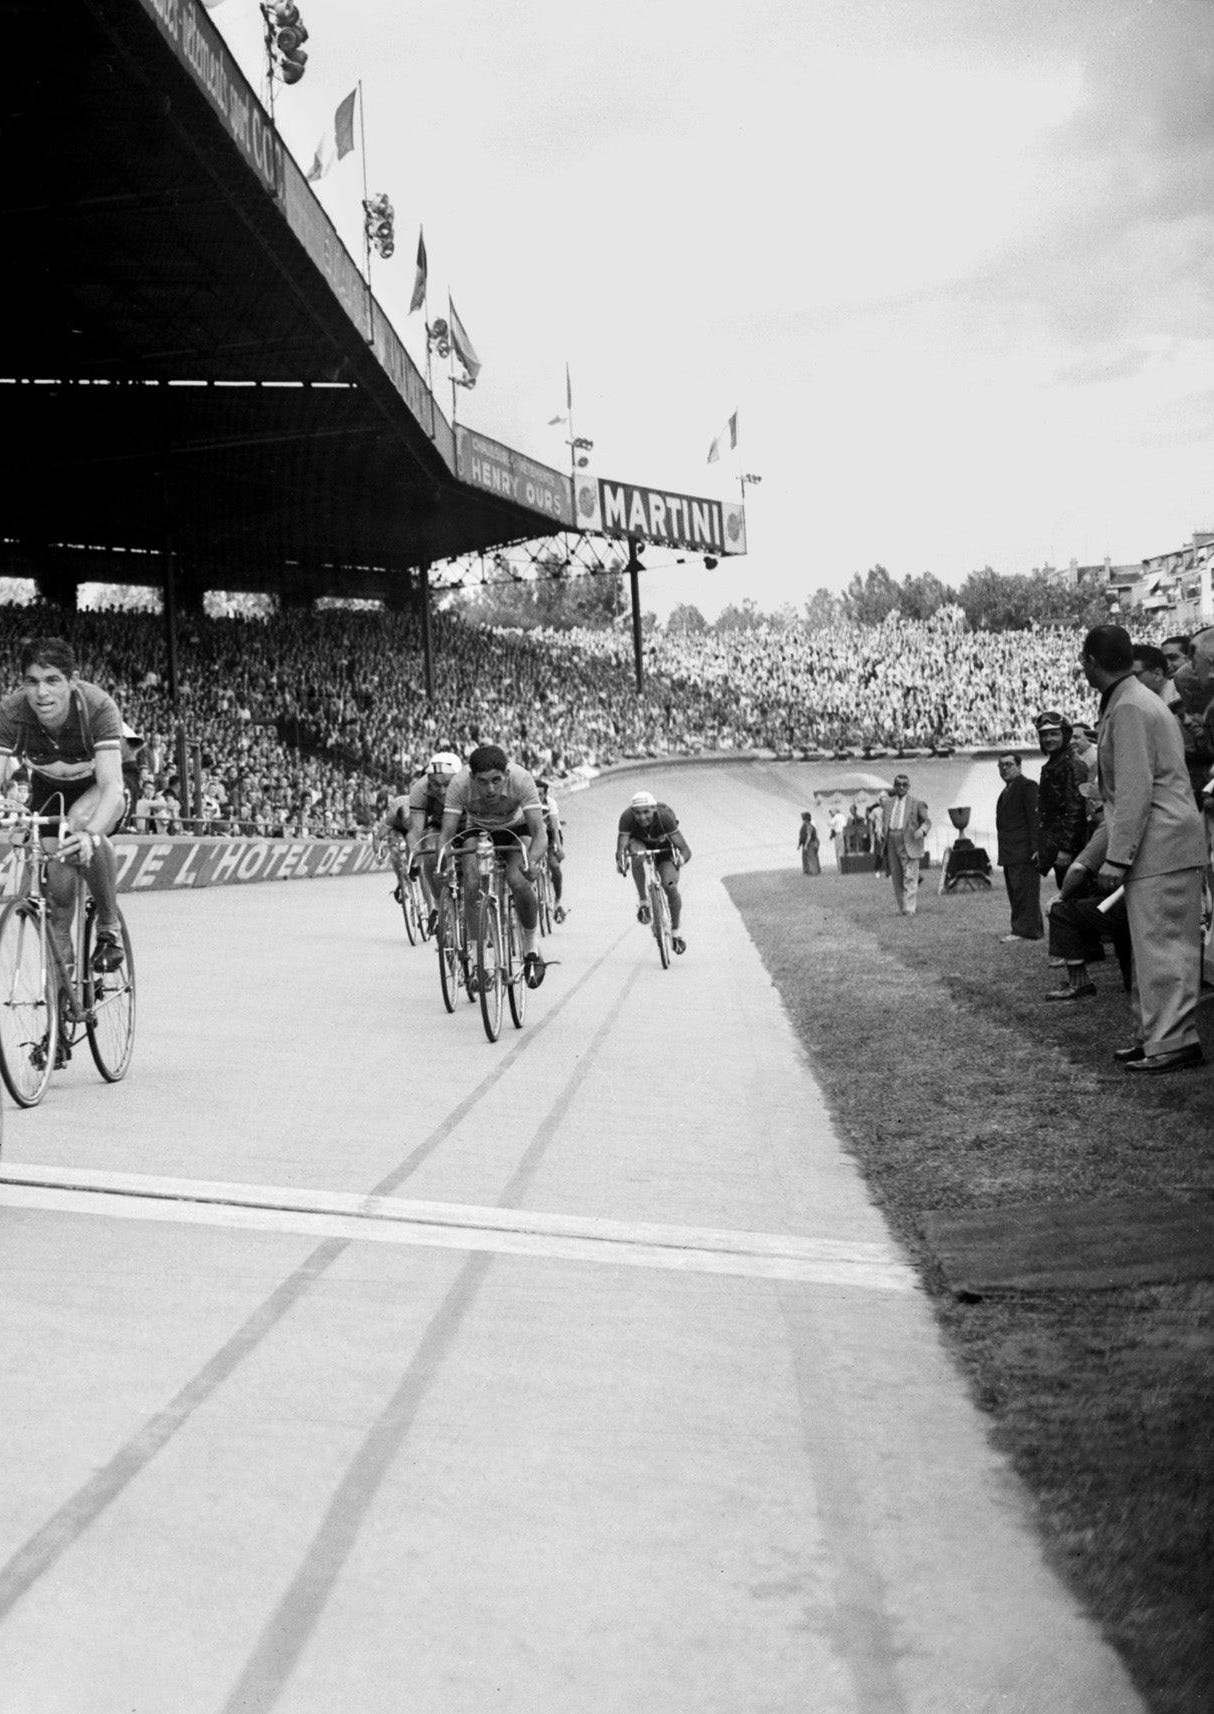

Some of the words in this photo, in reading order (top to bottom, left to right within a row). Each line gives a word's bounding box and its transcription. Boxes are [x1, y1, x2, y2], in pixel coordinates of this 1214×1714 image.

[471, 456, 518, 499] HENRY
[526, 482, 561, 516] OURS
[603, 484, 721, 546] MARTINI
[115, 844, 173, 888] DE
[314, 845, 354, 874] DE
